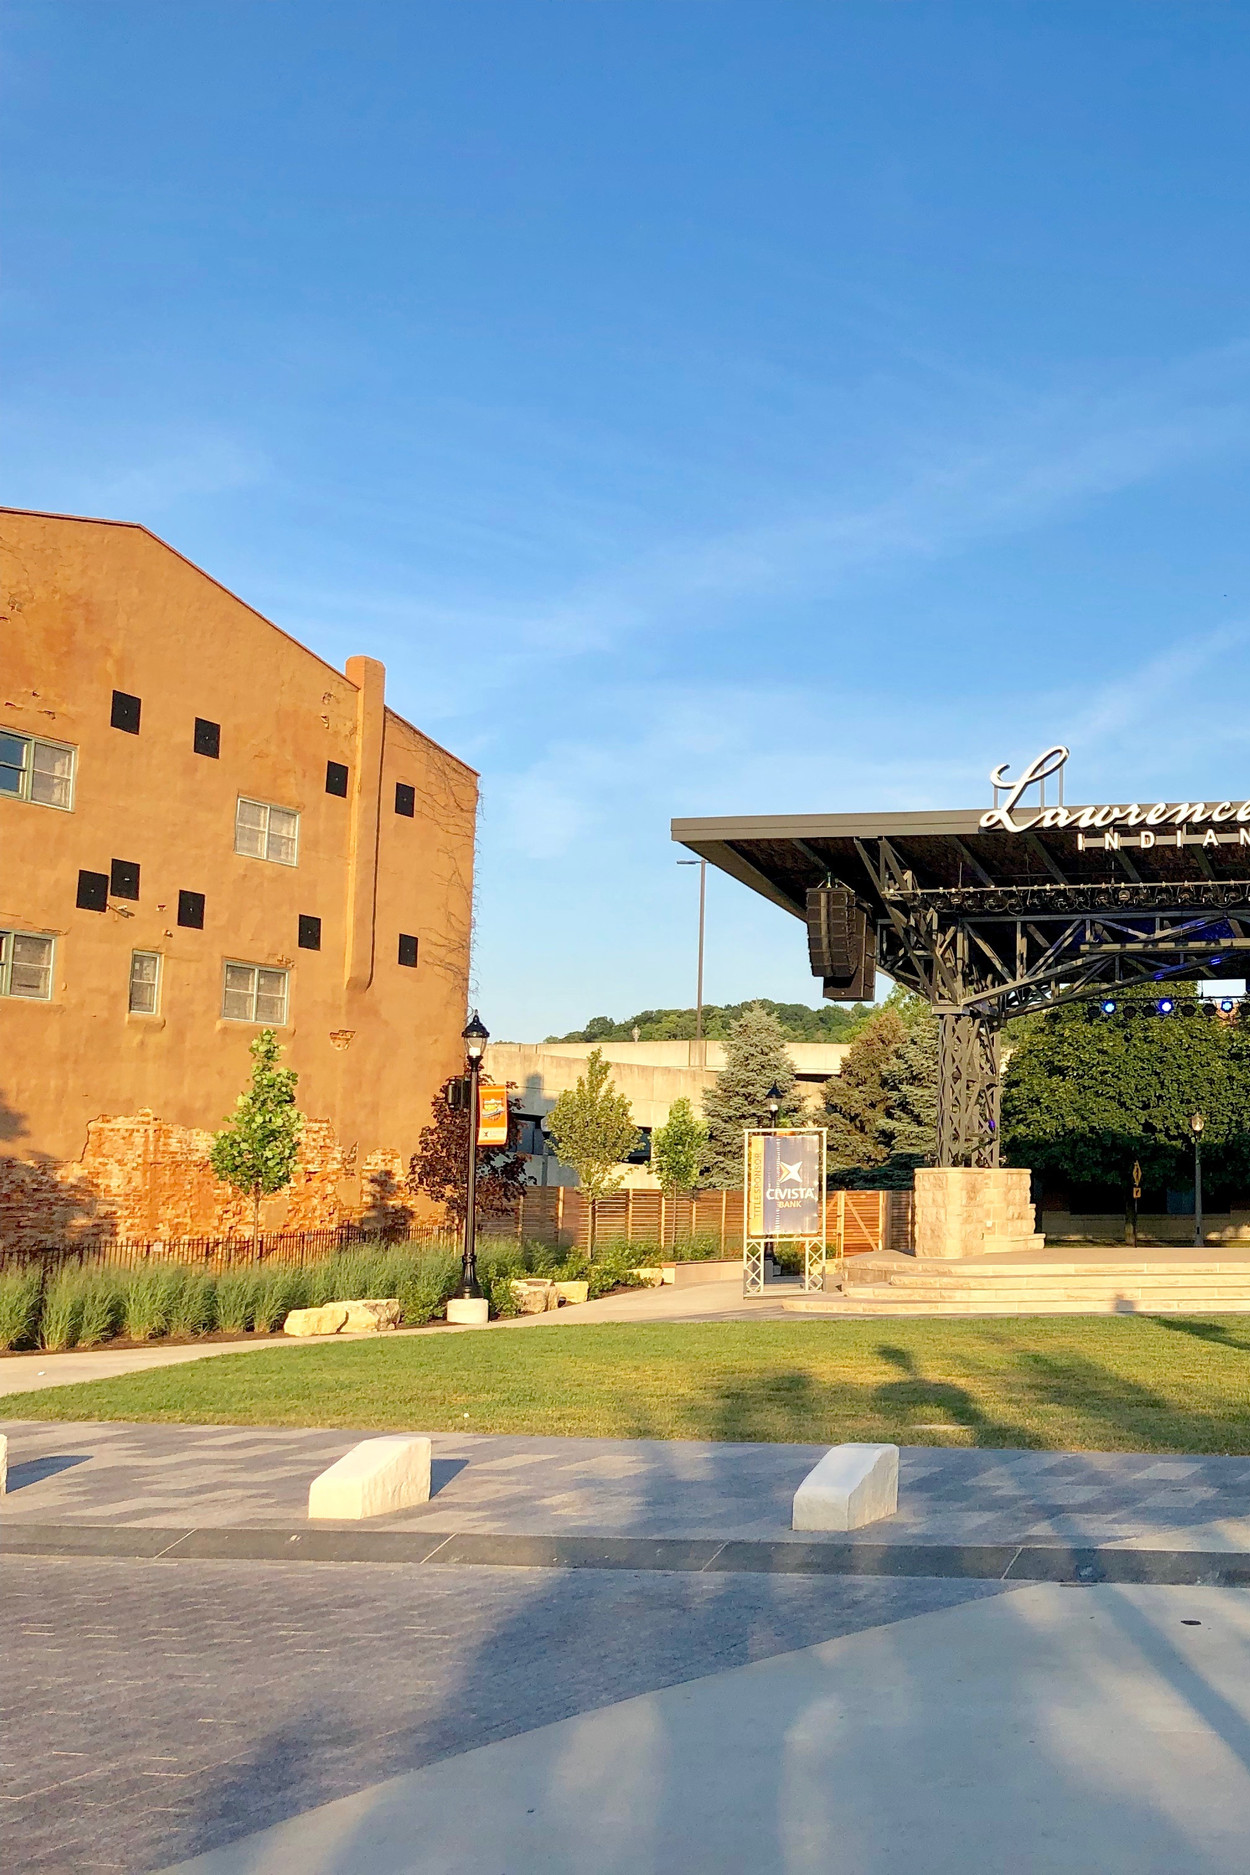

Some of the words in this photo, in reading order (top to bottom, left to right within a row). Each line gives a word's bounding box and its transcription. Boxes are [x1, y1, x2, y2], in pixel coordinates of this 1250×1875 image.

[754, 1153, 762, 1194] SPONSOR
[766, 1188, 814, 1200] CIVISTA
[754, 1195, 762, 1218] TITLE
[778, 1200, 802, 1208] BANK
